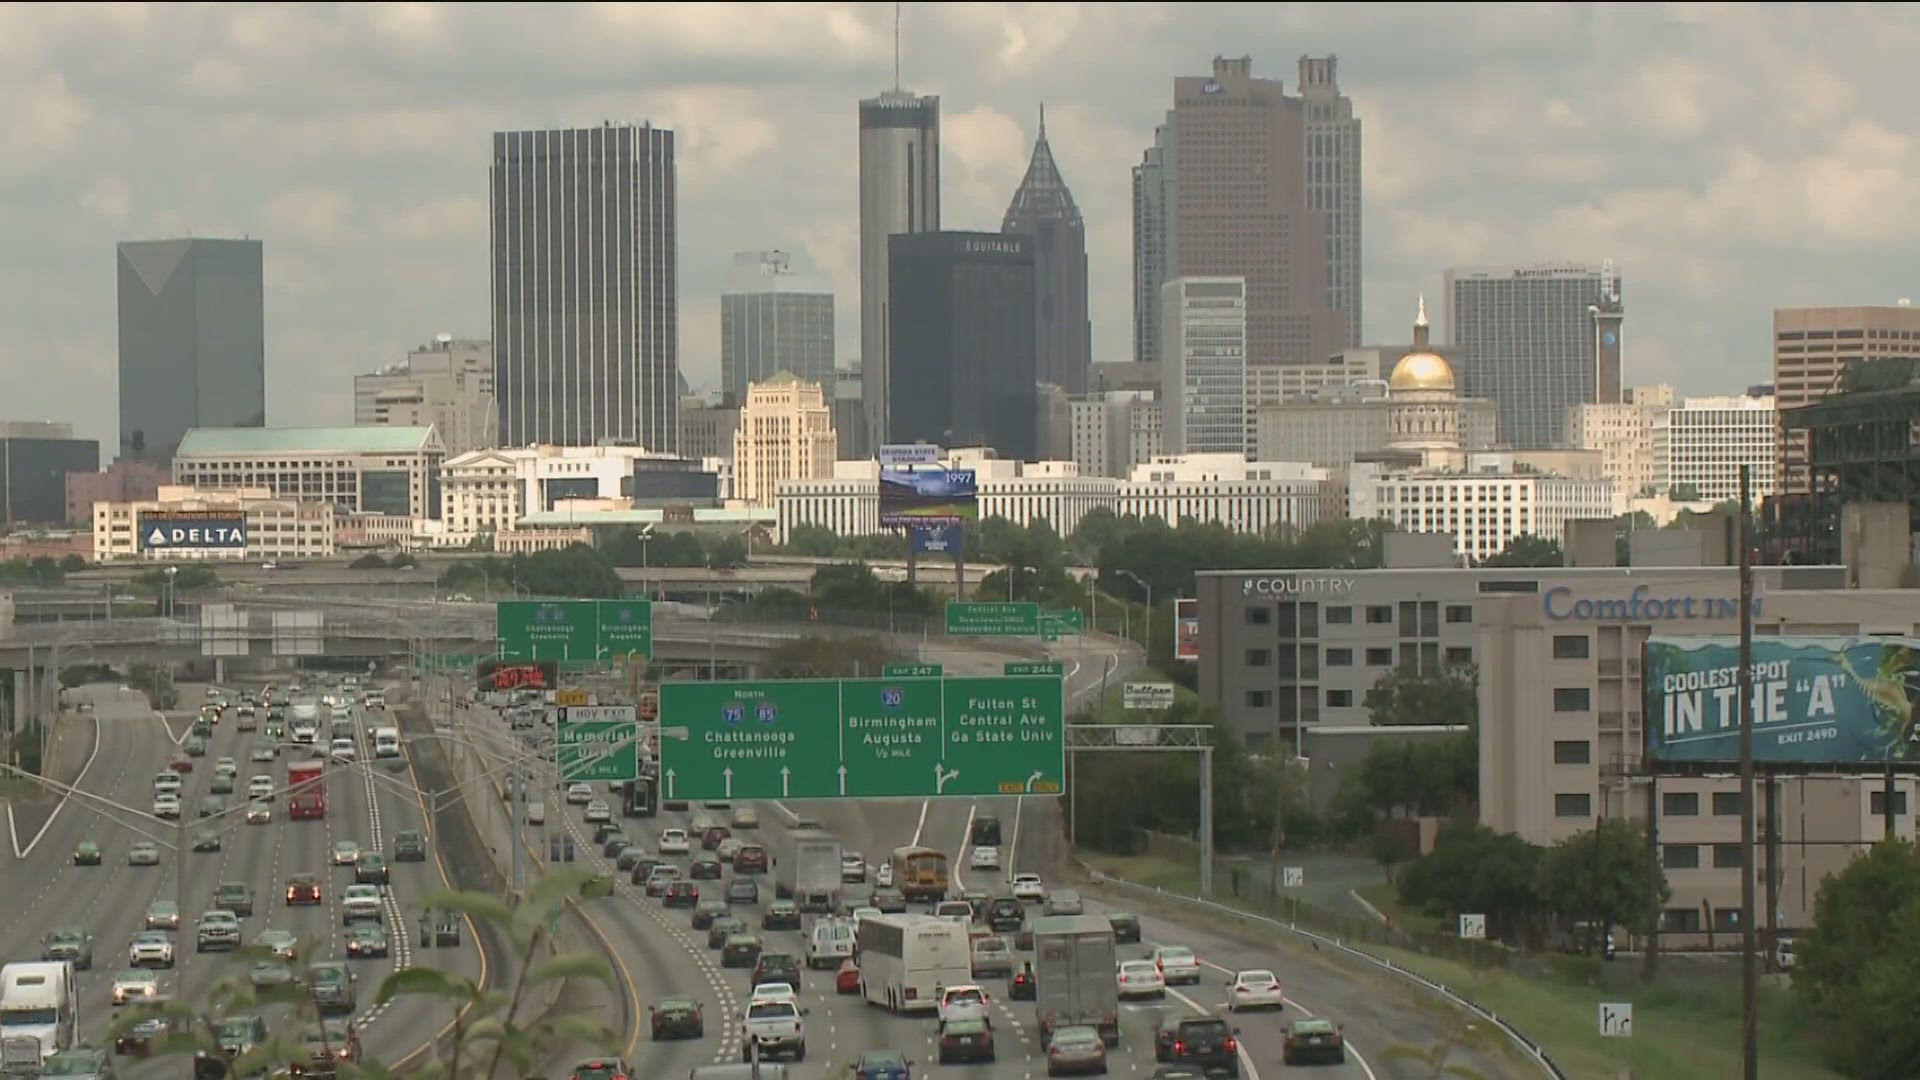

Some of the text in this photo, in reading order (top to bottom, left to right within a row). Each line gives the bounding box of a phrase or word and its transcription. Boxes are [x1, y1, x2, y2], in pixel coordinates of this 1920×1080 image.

[966, 240, 1020, 253] EQUITABLE
[945, 472, 972, 484] 1997
[172, 528, 243, 543] DELTA
[1256, 578, 1355, 593] COUNTRY
[1544, 584, 1696, 621] Comfort
[911, 667, 932, 675] 247
[1031, 665, 1054, 674] 246
[1664, 666, 1739, 694] COOLEST
[885, 693, 900, 705] 20
[968, 698, 1037, 710] Fulton St
[576, 708, 626, 718] HOV EXIT
[1664, 690, 1703, 736] IN
[1713, 680, 1788, 729] THE
[726, 709, 774, 721] 75 85
[960, 714, 1046, 726] Central Ave
[849, 716, 937, 729] Birmingham
[705, 730, 795, 744] Chattanooga
[863, 732, 922, 746] Augusta
[951, 730, 1053, 743] Ga State Univ
[1777, 727, 1838, 745] EXIT 249D
[713, 746, 787, 759] Greenville
[891, 749, 911, 757] MILE
